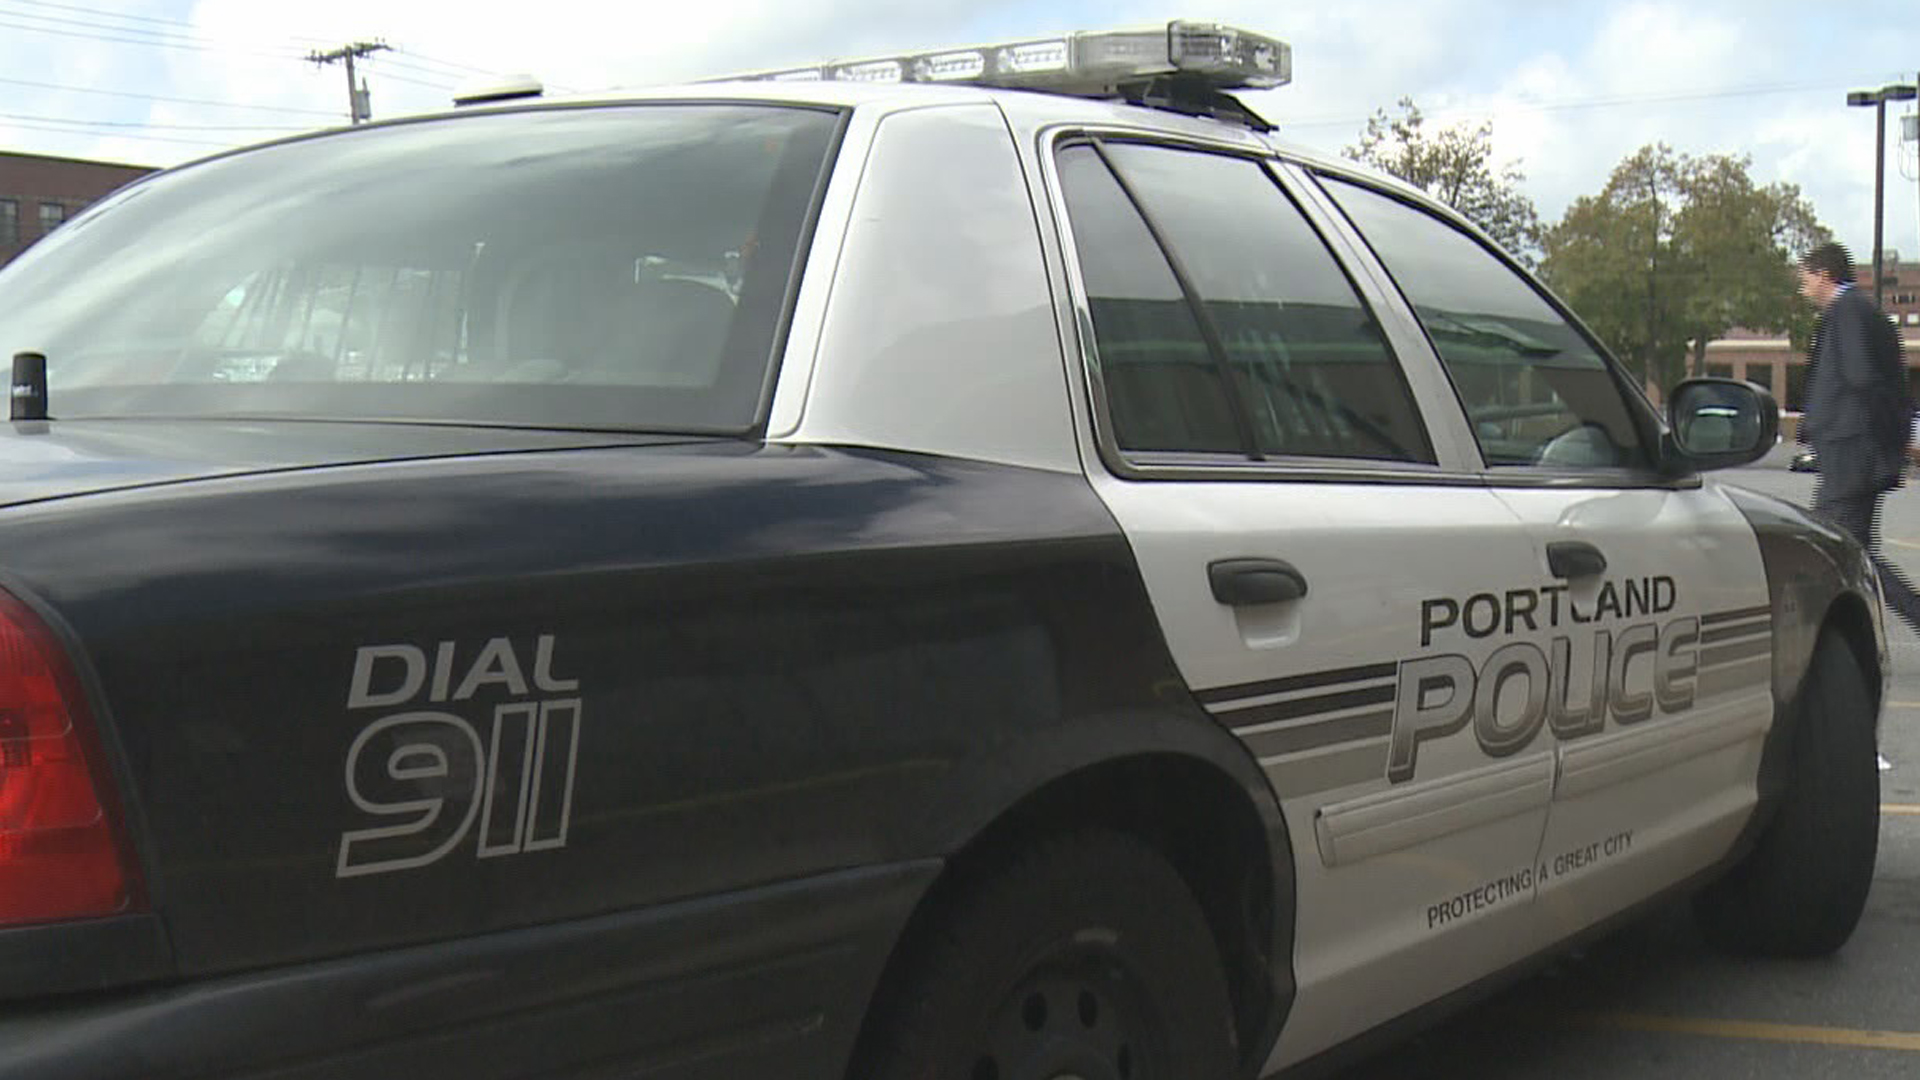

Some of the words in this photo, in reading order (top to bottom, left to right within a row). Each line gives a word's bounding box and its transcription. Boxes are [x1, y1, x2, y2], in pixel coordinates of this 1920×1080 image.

[347, 634, 579, 709] DIAL
[1386, 616, 1700, 785] POLICE
[335, 698, 582, 878] 911
[1427, 868, 1532, 929] PROTECTING
[1539, 864, 1548, 883] A
[1554, 843, 1599, 876] GREAT
[1604, 830, 1633, 856] CITY
